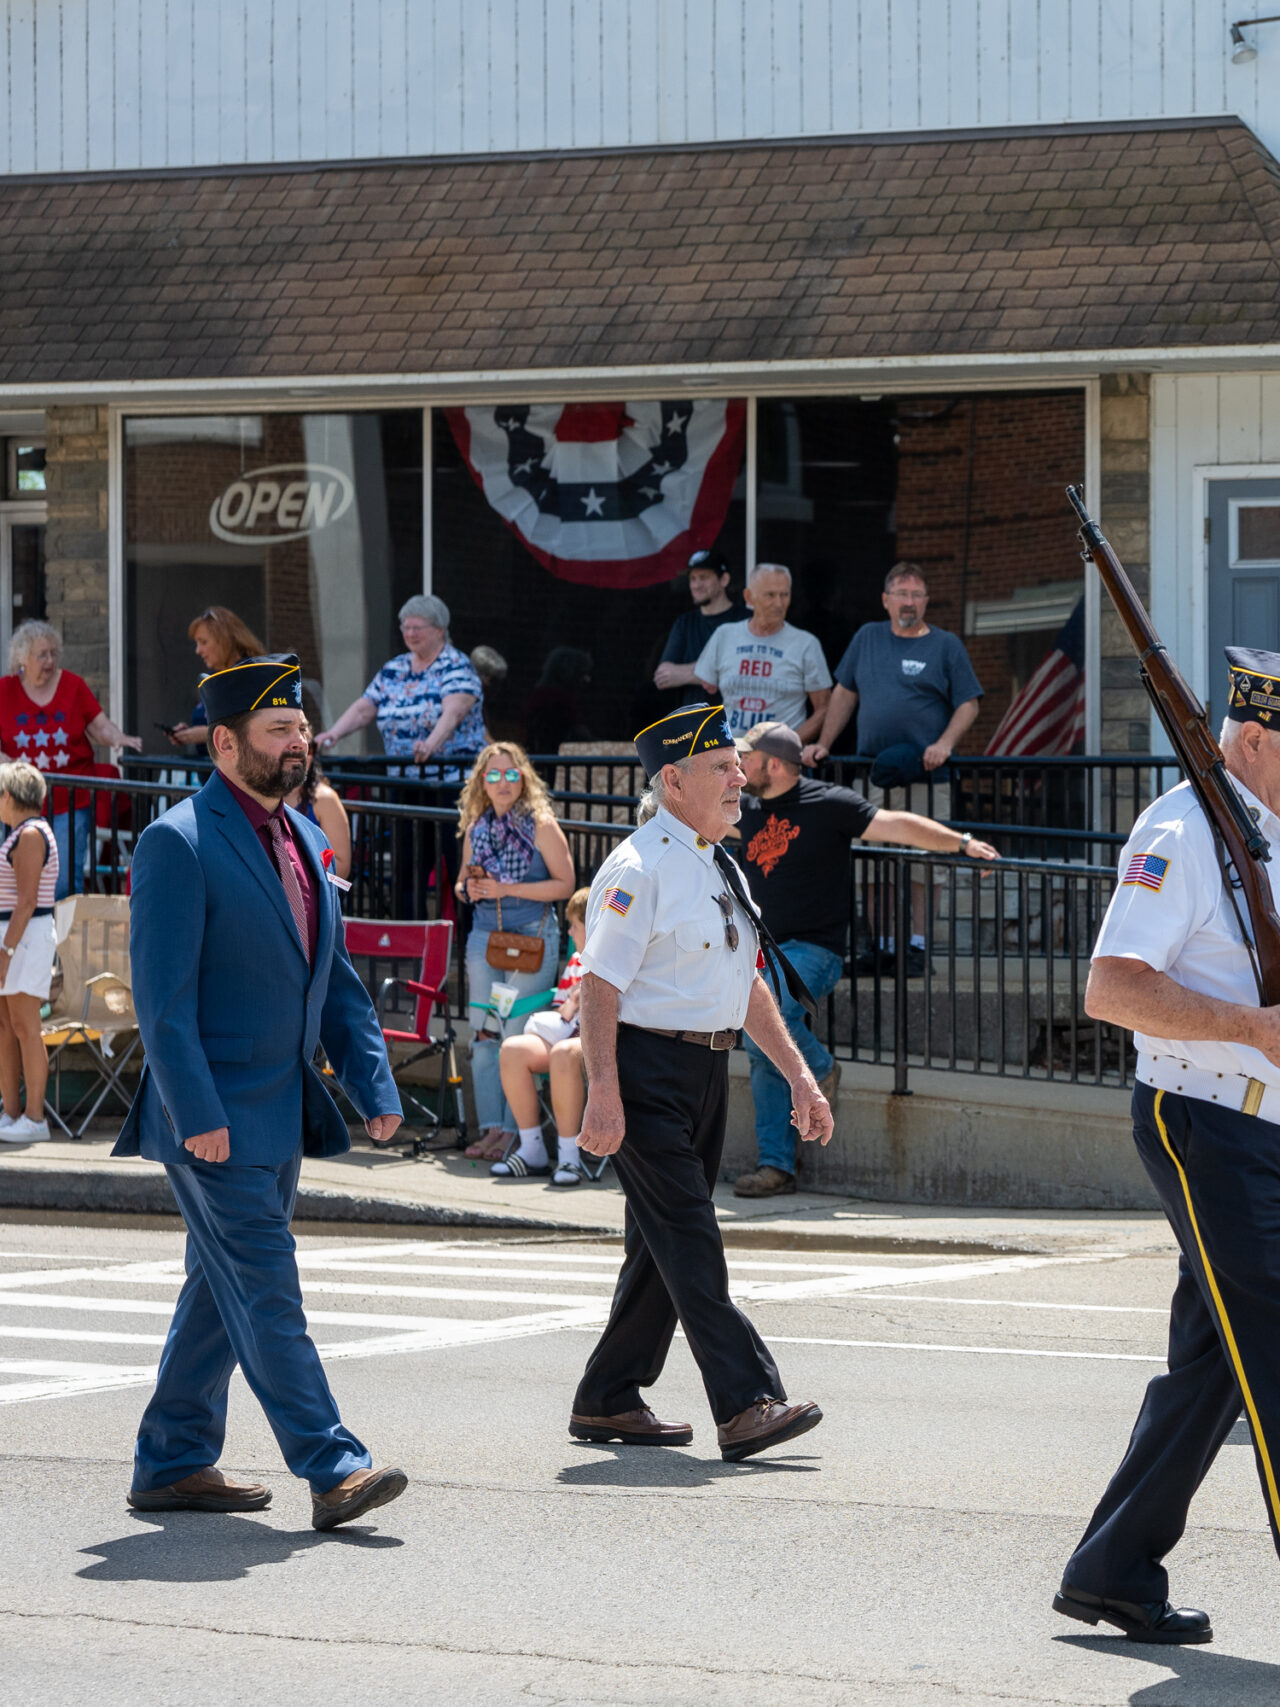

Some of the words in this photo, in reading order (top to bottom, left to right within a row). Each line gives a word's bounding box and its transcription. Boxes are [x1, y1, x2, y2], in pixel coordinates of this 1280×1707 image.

[219, 481, 338, 529] OPEN
[739, 659, 773, 677] RED
[272, 697, 287, 706] 814
[704, 738, 719, 748] 814
